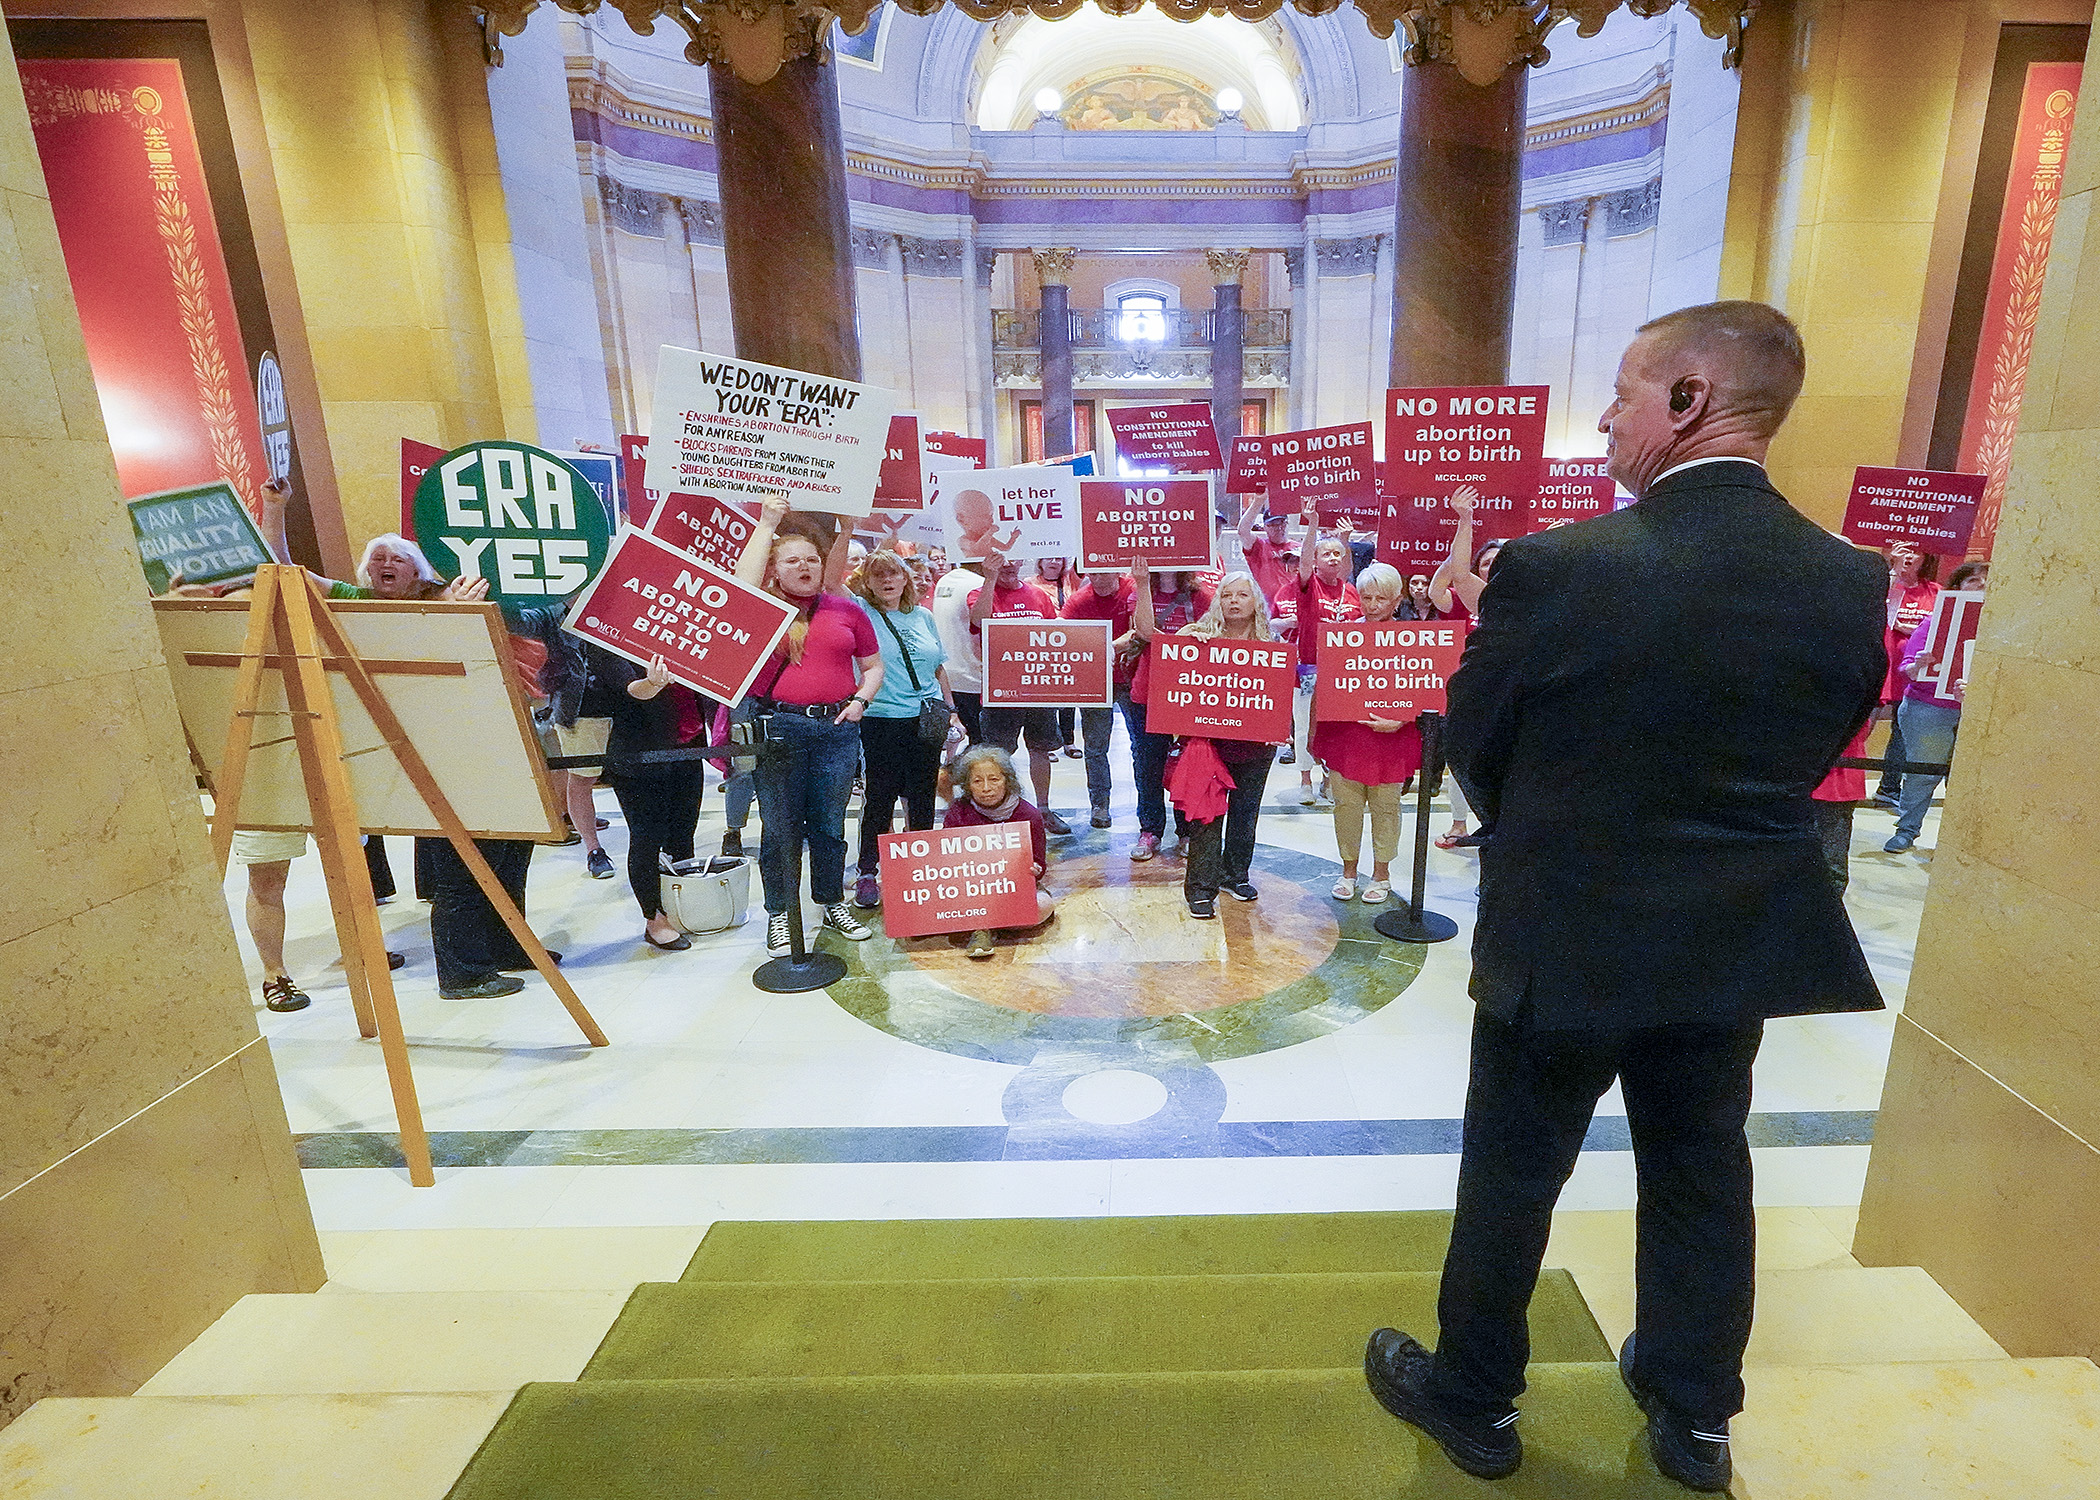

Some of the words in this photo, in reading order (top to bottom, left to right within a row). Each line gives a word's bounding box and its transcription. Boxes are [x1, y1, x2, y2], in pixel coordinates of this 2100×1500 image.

[262, 358, 286, 426] ERA
[800, 380, 860, 409] WANT
[715, 389, 770, 417] YOUR
[1396, 397, 1438, 416] NO
[1449, 396, 1536, 415] MORE
[1150, 411, 1168, 419] NO
[684, 423, 704, 435] FOR
[743, 419, 790, 434] ABORTION
[791, 427, 832, 441] THROUGH
[835, 434, 860, 446] BIRTH
[1116, 420, 1209, 432] CONSTITUTIONAL
[1132, 430, 1198, 440] AMENDMENT
[1416, 424, 1511, 441] abortion
[1152, 442, 1163, 450] to
[1166, 441, 1184, 449] kill
[1237, 442, 1262, 452] NO
[1272, 440, 1299, 456] NO
[1306, 430, 1366, 452] MORE
[266, 430, 291, 480] YES
[718, 443, 752, 457] PARENTS
[754, 449, 776, 460] FROM
[779, 451, 811, 465] SAVING
[811, 456, 835, 469] THEIR
[1131, 451, 1170, 459] unborn
[1173, 450, 1210, 458] babies
[1404, 449, 1431, 465] up
[1439, 448, 1461, 461] to
[1468, 445, 1521, 461] birth
[680, 452, 710, 464] YOUNG
[712, 455, 764, 470] DAUGHTERS
[765, 459, 786, 472] FROM
[786, 465, 827, 479] ABORTION
[717, 466, 735, 478] SEX
[1240, 468, 1256, 477] up
[1287, 455, 1351, 473] abortion
[1549, 464, 1608, 476] MORE
[440, 448, 577, 530] ERA
[679, 476, 700, 487] WITH
[703, 478, 744, 492] ABORTION
[746, 485, 791, 499] ANONYMITY
[1281, 478, 1299, 492] up
[1304, 474, 1319, 487] to
[1325, 469, 1361, 484] birth
[1538, 483, 1592, 495] ortion
[1907, 476, 1930, 487] NO
[1002, 488, 1023, 500] let
[1028, 487, 1056, 499] her
[1125, 488, 1165, 505] NO
[1858, 486, 1975, 504] CONSTITUTIONAL
[999, 503, 1063, 521] LIVE
[1414, 497, 1437, 511] up
[1541, 498, 1560, 509] to
[1562, 497, 1599, 510] birth
[1870, 498, 1956, 513] AMENDMENT
[148, 506, 185, 531] AM
[193, 498, 231, 522] AN
[709, 506, 747, 541] NO
[1096, 510, 1195, 522] ABORTION
[1889, 513, 1903, 522] to
[1907, 514, 1929, 525] kill
[676, 511, 741, 558] ABORTI
[1121, 523, 1143, 534] UP
[1149, 523, 1171, 534] TO
[1857, 521, 1905, 533] unborn
[1909, 525, 1957, 539] babies
[1118, 536, 1175, 547] BIRTH
[1390, 541, 1410, 553] up
[1415, 540, 1430, 551] to
[166, 545, 259, 576] VOTER
[694, 535, 716, 553] UP
[720, 551, 737, 570] TO
[438, 537, 589, 595] YES
[672, 569, 729, 608] NO
[622, 577, 751, 645] ABORTION
[992, 610, 1043, 618] CONSTITUTION
[647, 605, 680, 625] UP
[684, 621, 712, 644] TO
[632, 616, 709, 661] BIRTH
[1029, 631, 1067, 647] NO
[1326, 630, 1364, 647] NO
[1375, 630, 1454, 647] MORE
[1002, 651, 1093, 662] ABORTION
[1161, 643, 1199, 661] NO
[1209, 647, 1288, 668] MORE
[1345, 655, 1433, 670] abortion
[1024, 664, 1046, 673] UP
[1050, 664, 1071, 673] TO
[1021, 675, 1075, 685] BIRTH
[1178, 670, 1265, 691] abortion
[1335, 677, 1361, 693] up
[1367, 674, 1388, 689] to
[1395, 673, 1444, 689] birth
[1167, 690, 1193, 707] up
[1199, 690, 1220, 706] to
[1226, 691, 1274, 710] birth
[1364, 700, 1413, 708] MCCL.ORG
[1195, 717, 1242, 727] MCCL.ORG
[889, 840, 930, 860] NO
[941, 832, 1022, 855] MORE
[912, 860, 1004, 882] abortion
[903, 890, 930, 905] up
[936, 883, 959, 900] to
[966, 878, 1016, 897] birth
[936, 908, 987, 920] MCCL.ORG
